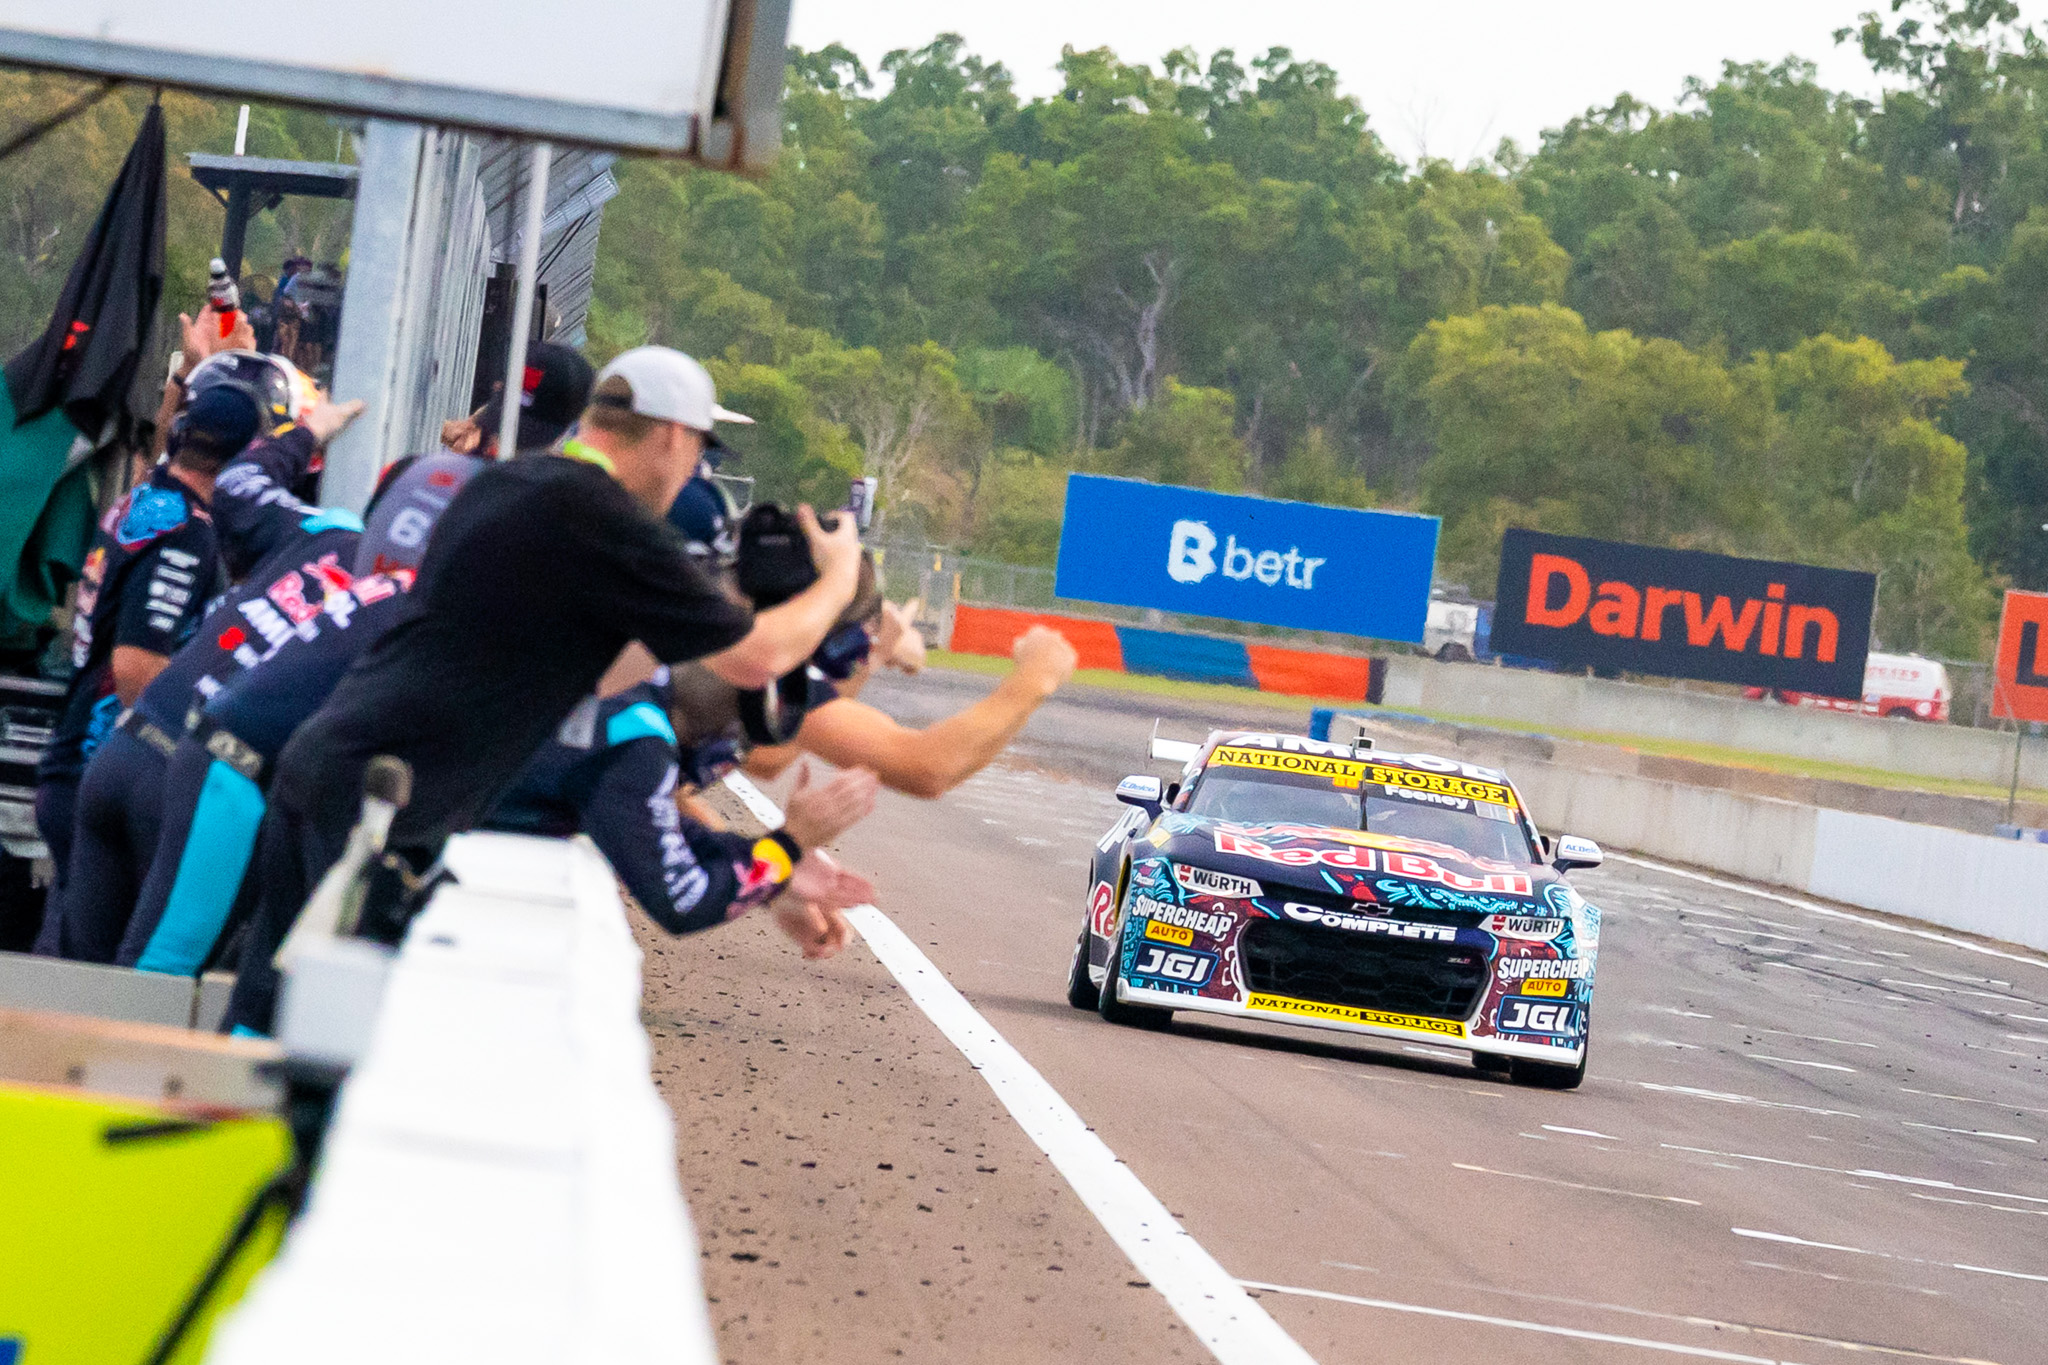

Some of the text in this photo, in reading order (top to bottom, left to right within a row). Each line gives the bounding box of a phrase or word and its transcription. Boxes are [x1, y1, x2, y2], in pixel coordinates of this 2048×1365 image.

[1222, 534, 1327, 590] betr
[1525, 553, 1839, 663] Darwin
[1218, 750, 1504, 802] NATIONAL STORAGE
[1384, 786, 1468, 810] Feeney
[1214, 831, 1533, 896] Red Bull
[1194, 870, 1251, 895] WÜRTH
[1132, 895, 1232, 937] SUPERCHEAP
[1508, 917, 1561, 934] WÜRTH
[1151, 925, 1188, 941] AUTO
[1136, 949, 1210, 982] JGI
[1497, 957, 1589, 979] SUPERCHEAP
[1527, 981, 1562, 992] AUTO
[1250, 997, 1459, 1035] NATIONAL STORAGE
[1503, 1003, 1570, 1032] JGI
